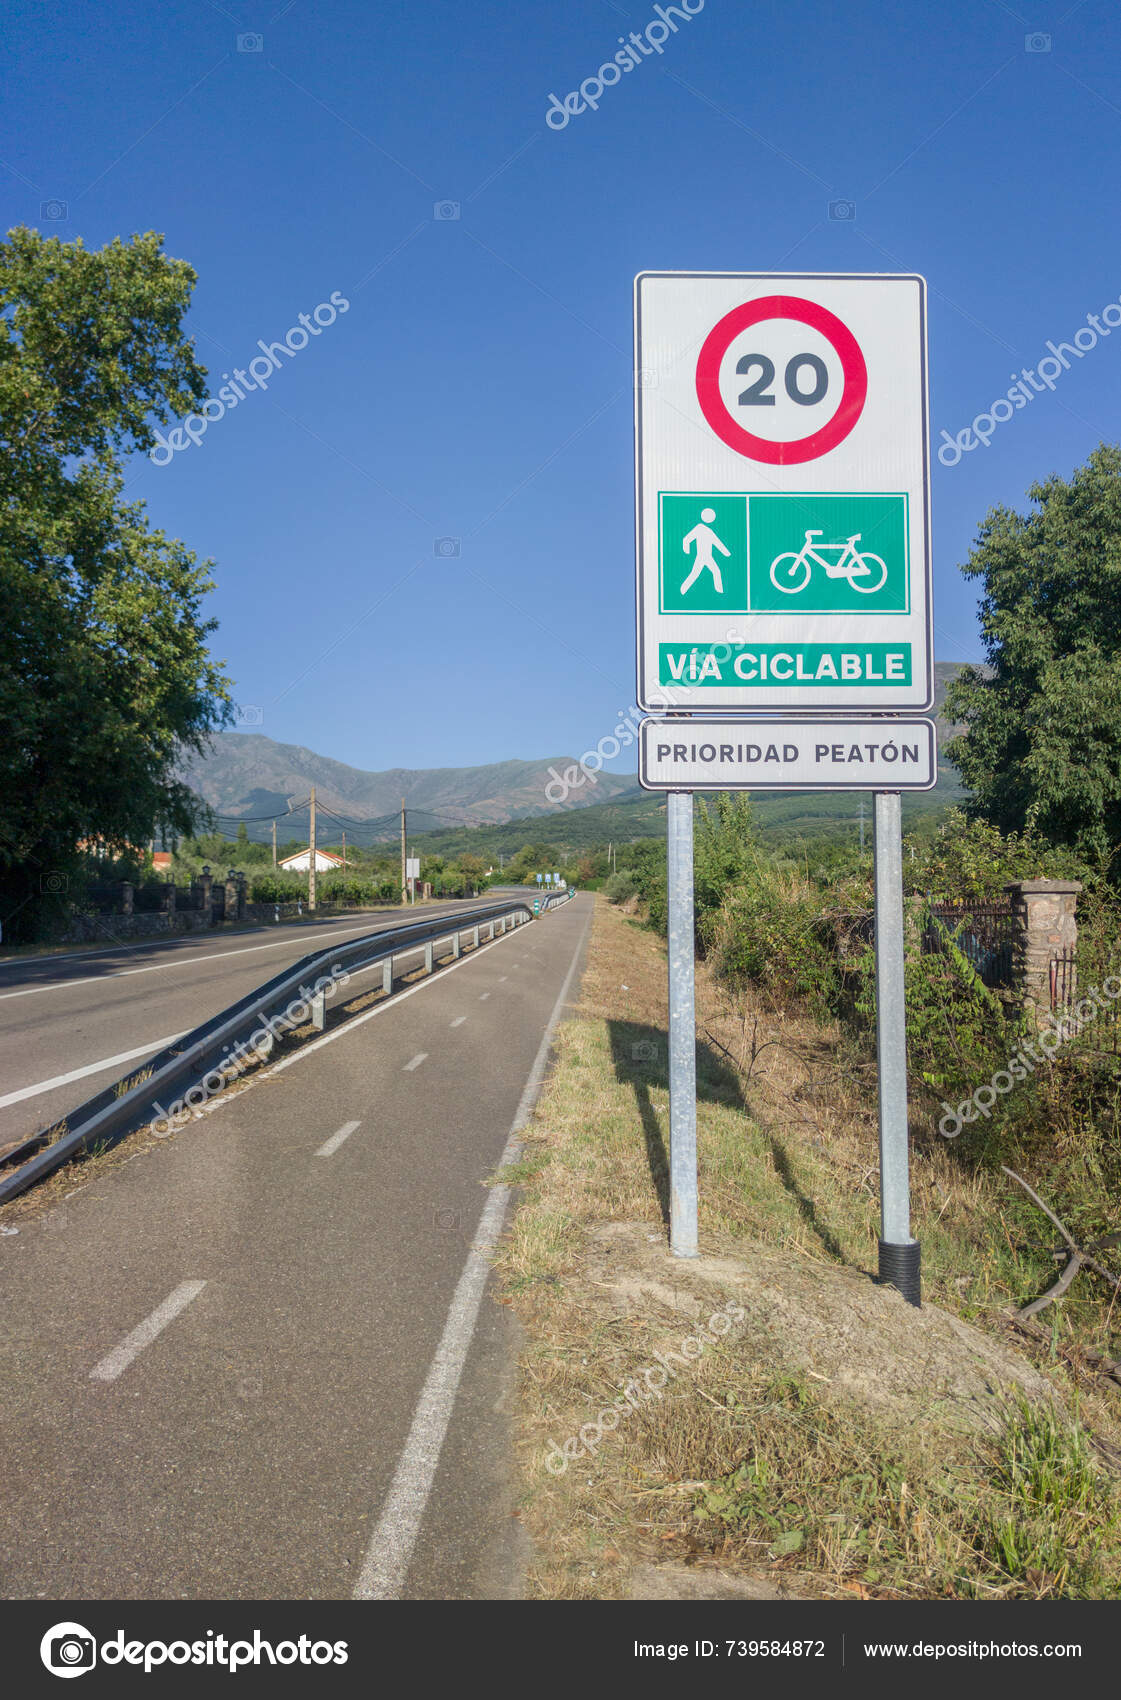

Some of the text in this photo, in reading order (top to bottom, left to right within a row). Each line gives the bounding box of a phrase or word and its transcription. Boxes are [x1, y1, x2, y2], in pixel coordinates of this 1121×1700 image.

[735, 352, 829, 406] 20
[666, 648, 906, 681] VÍA CICLABLE
[656, 740, 919, 763] PRIORIDAD PEATÓN
